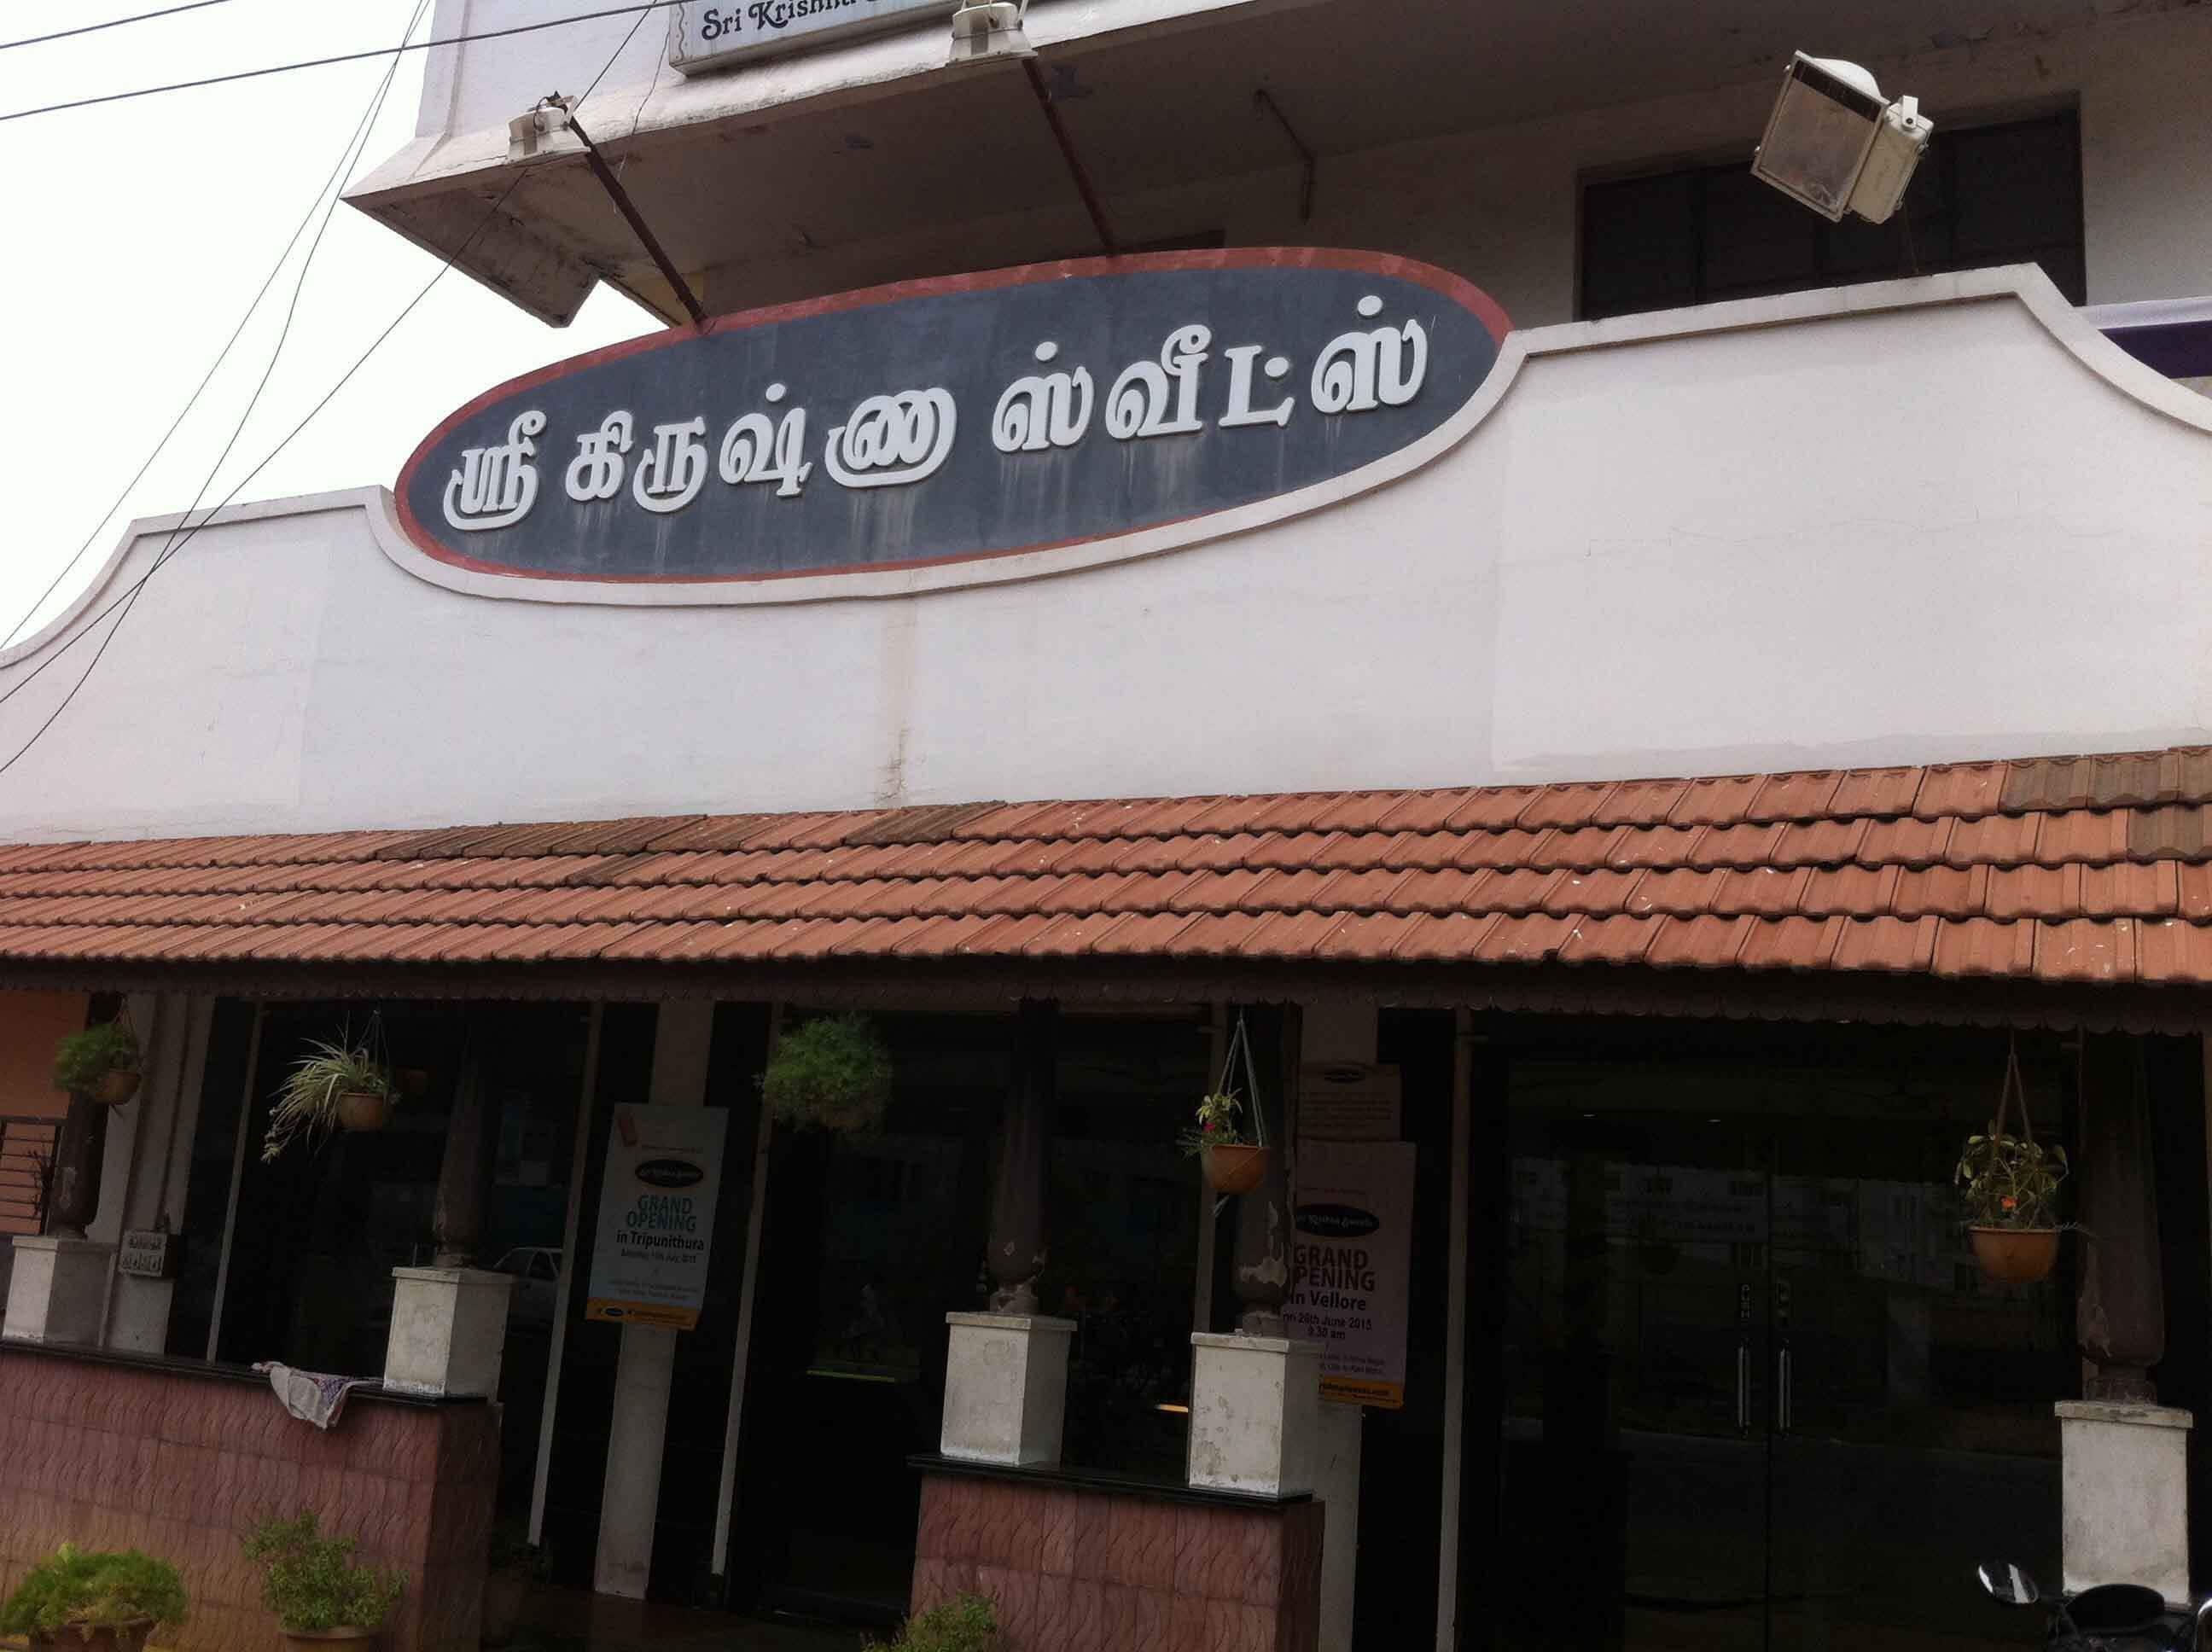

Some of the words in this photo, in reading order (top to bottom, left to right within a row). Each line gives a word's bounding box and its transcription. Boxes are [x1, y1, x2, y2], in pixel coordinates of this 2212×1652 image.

[701, 8, 741, 40] Sri
[748, 0, 857, 29] Krishn
[443, 410, 547, 531] ஸ்ரீ
[565, 382, 957, 514] கிருஷ்ண
[992, 294, 1429, 453] ஸ்வீட்ஸ்
[637, 1195, 693, 1215] GRAND
[627, 1209, 697, 1231] OPENING
[616, 1229, 628, 1243] in
[631, 1230, 705, 1251] Tripunithura
[1294, 1244, 1369, 1271] GRAND
[1296, 1266, 1376, 1292] PENING
[1310, 1289, 1367, 1311] Vellore
[1330, 1330, 1346, 1341] am
